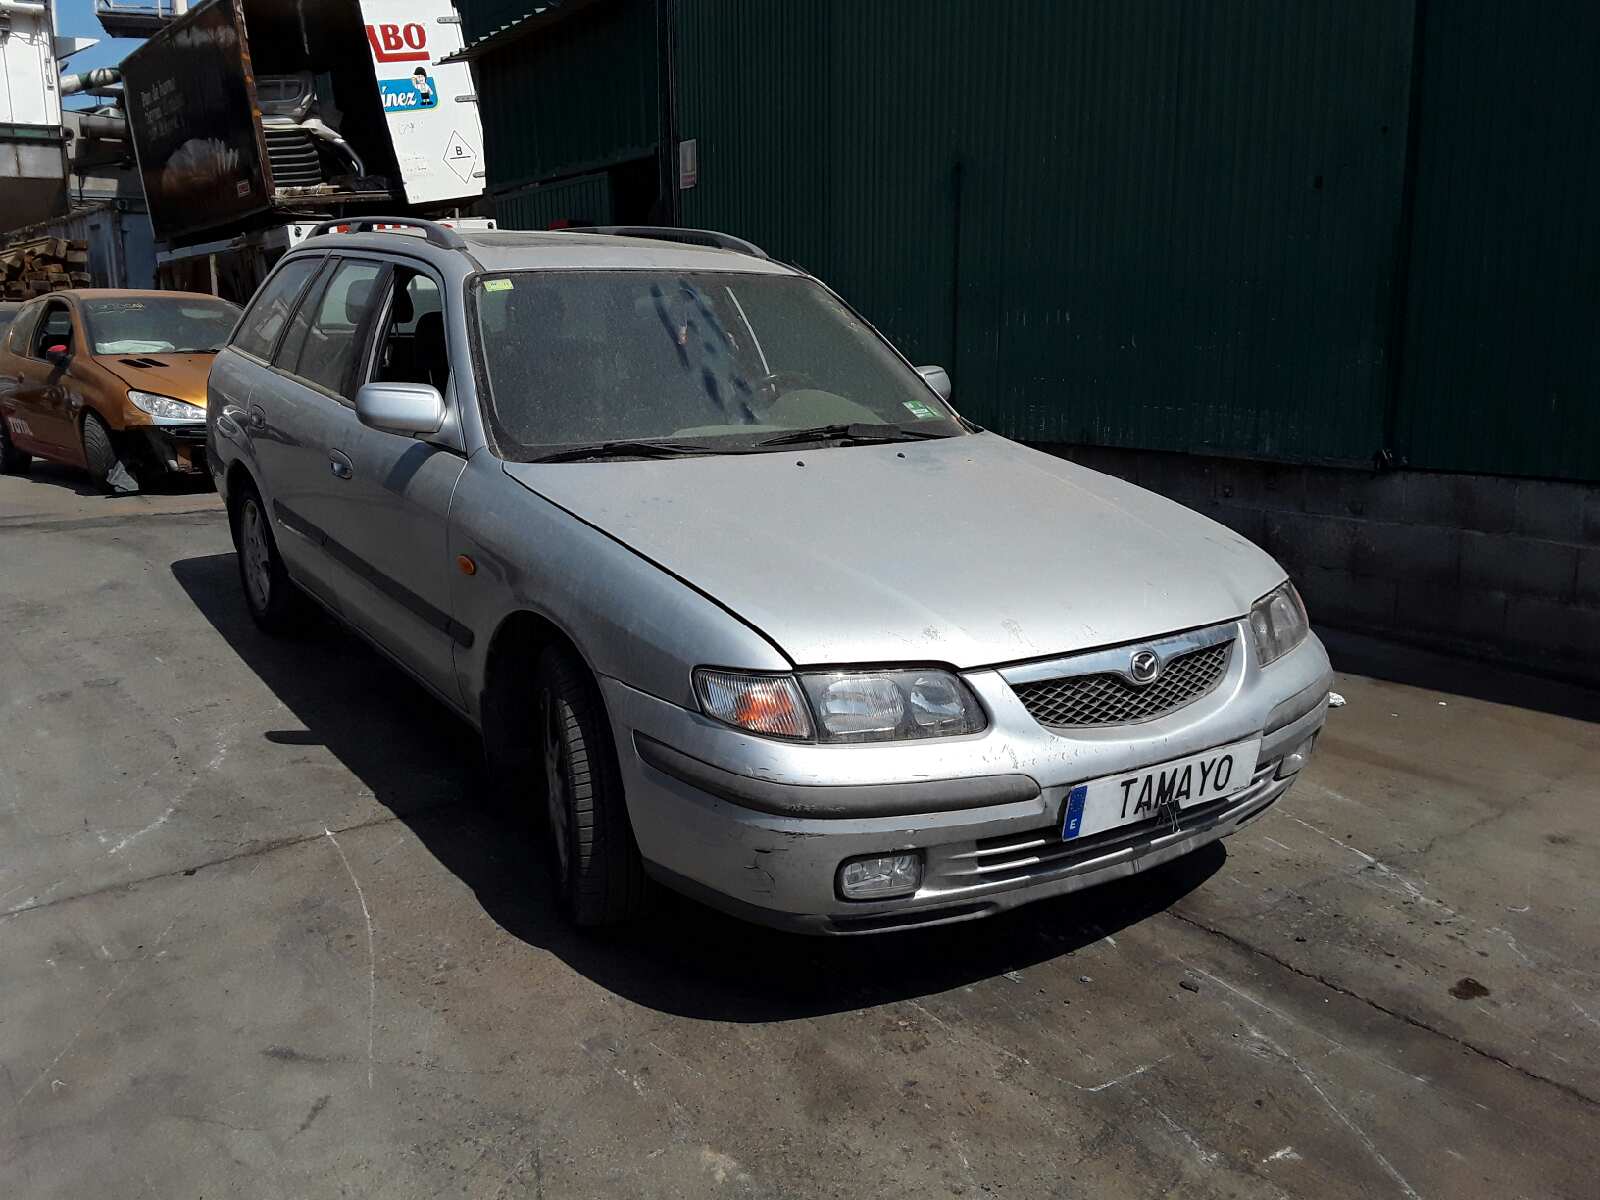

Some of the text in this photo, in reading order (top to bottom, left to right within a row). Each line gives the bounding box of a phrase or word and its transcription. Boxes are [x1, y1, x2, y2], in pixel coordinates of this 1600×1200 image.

[455, 146, 463, 156] B
[1120, 754, 1234, 819] TAMAYO
[1069, 818, 1078, 830] E
